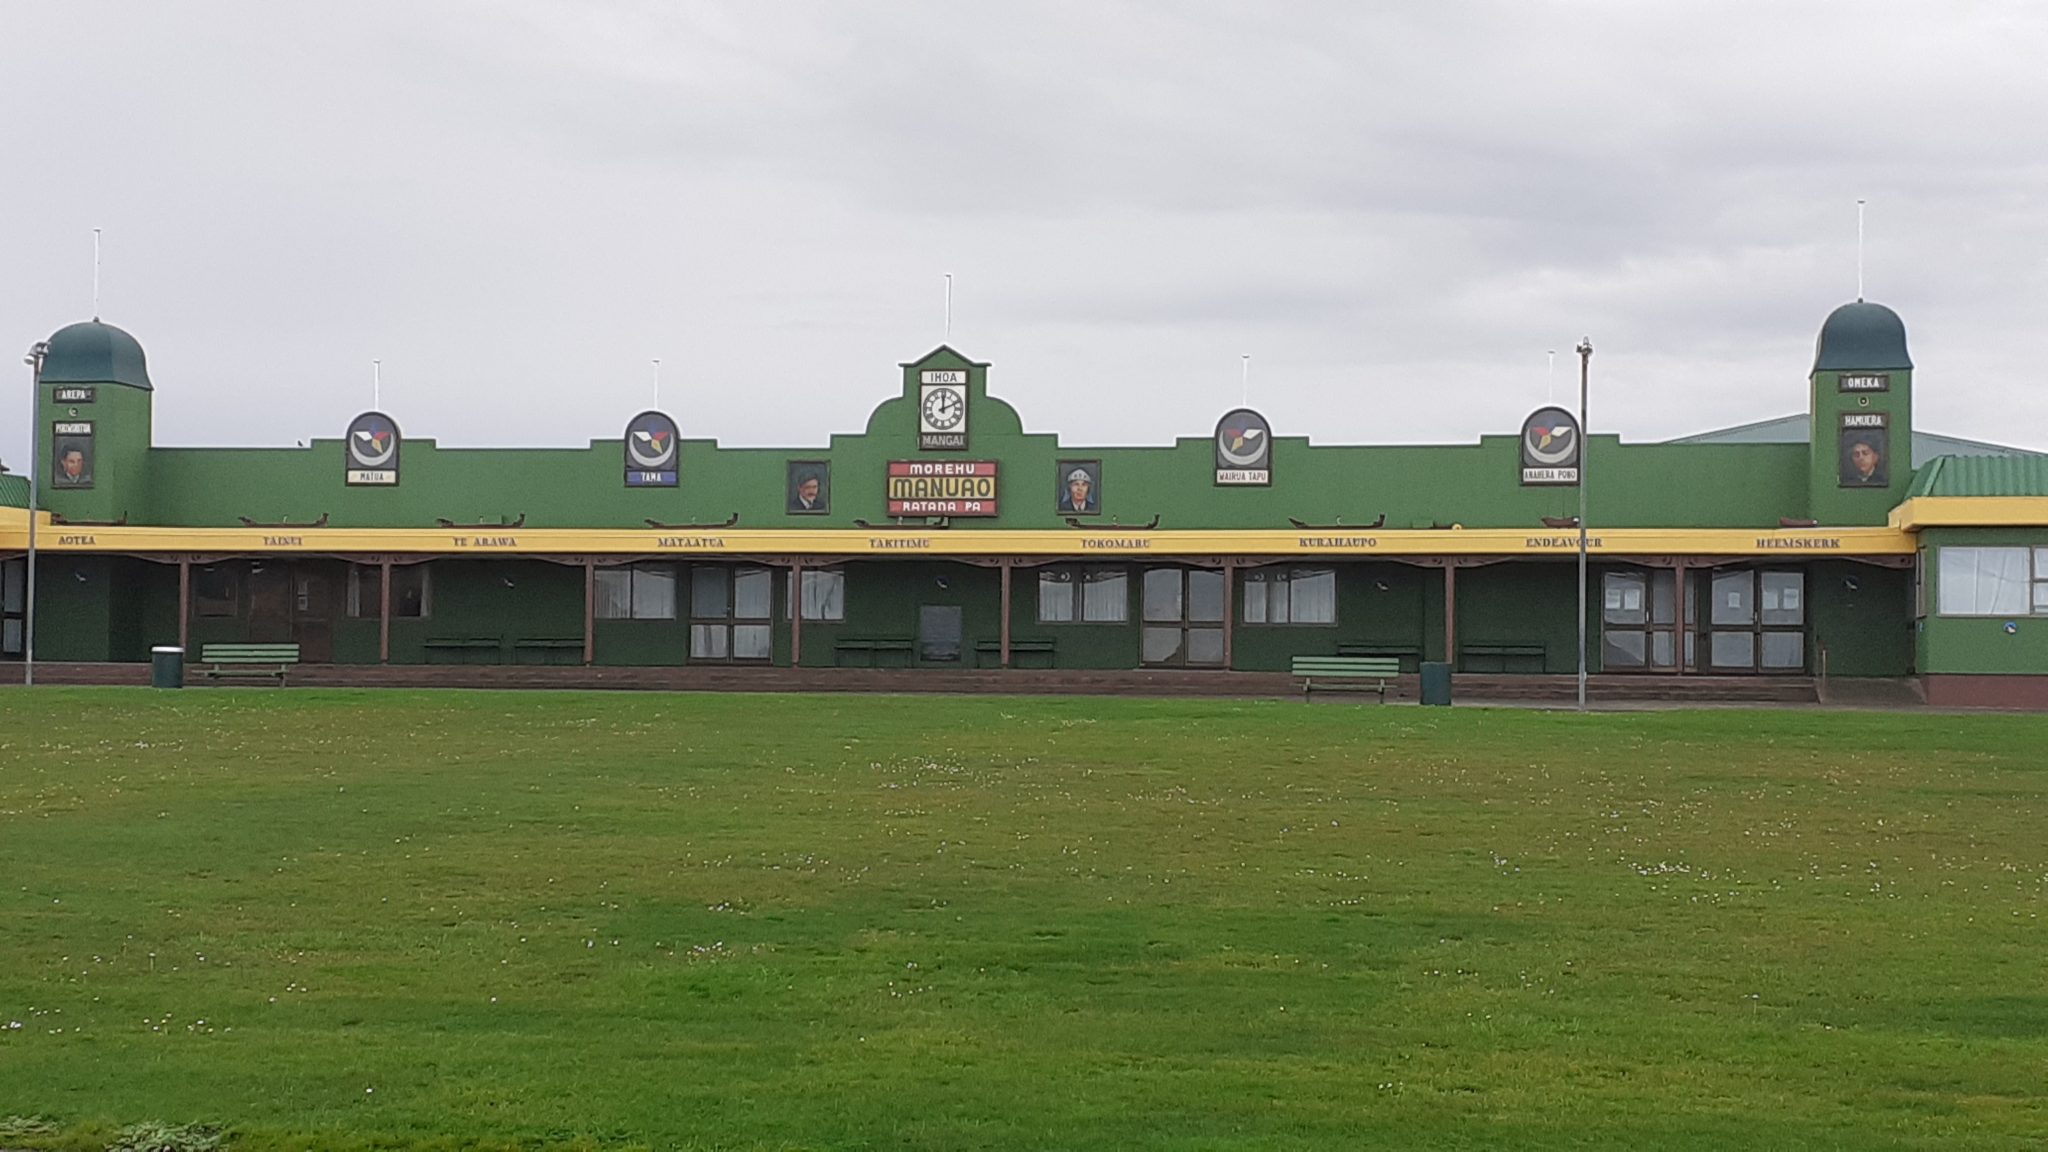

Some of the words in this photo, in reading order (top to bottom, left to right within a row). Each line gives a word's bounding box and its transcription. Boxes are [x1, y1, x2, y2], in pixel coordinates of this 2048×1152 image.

[930, 372, 957, 382] IHOA
[1847, 376, 1880, 388] OMEKA
[61, 389, 86, 400] AREPA
[922, 434, 964, 446] MANGAI
[909, 463, 976, 475] MOREHU
[360, 472, 384, 481] MATUA
[640, 471, 662, 482] TAMA
[1249, 471, 1266, 481] TAPU
[893, 478, 991, 497] MANUAO
[902, 501, 957, 512] RATANA
[965, 501, 981, 512] PA
[58, 535, 97, 545] AOTEA
[263, 536, 303, 546] TAINUI
[453, 537, 468, 546] TE
[473, 537, 517, 546] ARAWA
[657, 538, 725, 547] MATAATUA
[869, 538, 930, 548] TAKITIMU
[1081, 539, 1151, 548] TOKOMARU
[1299, 537, 1377, 547] KURAHAUPO
[1756, 538, 1841, 548] HEEMSKERK
